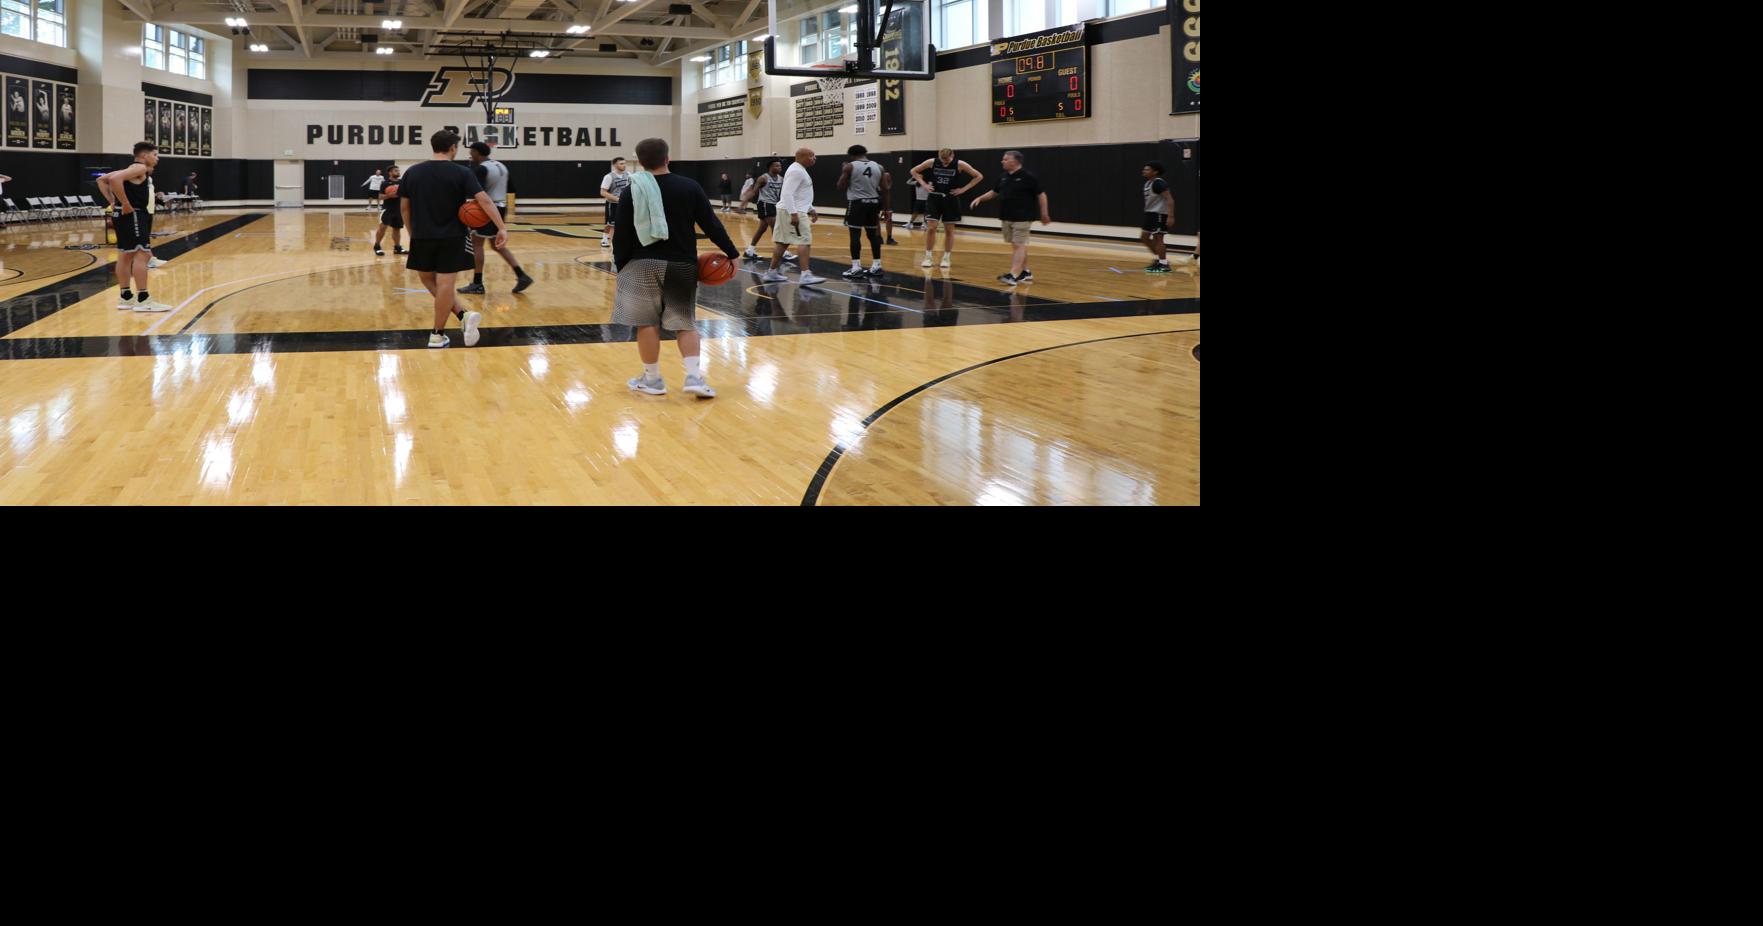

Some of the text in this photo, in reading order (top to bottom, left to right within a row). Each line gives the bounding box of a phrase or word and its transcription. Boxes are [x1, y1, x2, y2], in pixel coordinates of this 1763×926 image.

[1007, 39, 1036, 53] Purdue
[1037, 30, 1083, 48] Basketball
[1057, 67, 1078, 76] GUEST
[1070, 76, 1077, 90] 0
[1007, 84, 1014, 98] 0
[1075, 99, 1081, 110] 0
[1000, 106, 1006, 117] 0
[307, 125, 422, 145] PURDUE
[863, 166, 873, 179] 4
[937, 176, 950, 184] 32
